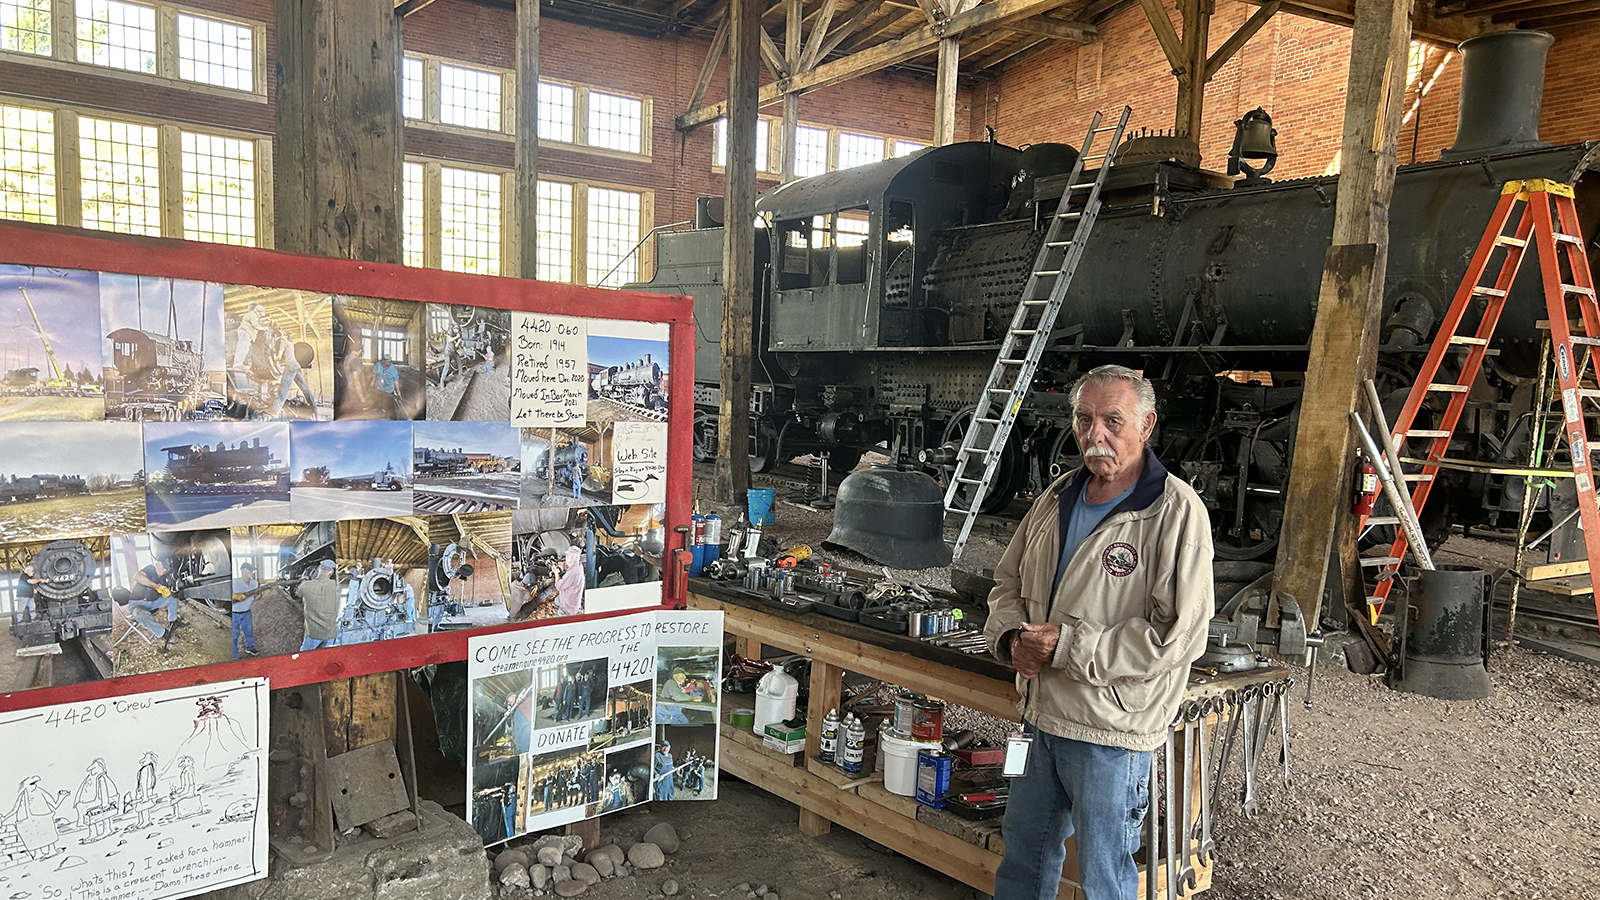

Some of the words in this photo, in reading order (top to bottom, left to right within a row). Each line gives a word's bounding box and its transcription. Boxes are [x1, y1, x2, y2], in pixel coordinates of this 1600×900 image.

[520, 317, 551, 333] 4420
[549, 339, 566, 352] 1914
[516, 353, 550, 369] Retired
[555, 358, 576, 370] 1957
[515, 368, 540, 383] Moved
[541, 371, 556, 383] here
[571, 373, 585, 383] 2020
[513, 387, 539, 399] Moved
[562, 388, 583, 398] March
[564, 398, 578, 407] 2021
[515, 407, 532, 420] Let
[617, 448, 638, 461] Web
[641, 446, 658, 460] Site
[475, 643, 521, 664] COME
[524, 638, 550, 657] SEE
[551, 635, 576, 652] THE
[577, 624, 638, 648] PROGRESS
[639, 622, 652, 638] TO
[654, 621, 710, 635] RESTORE
[619, 641, 641, 655] THE
[611, 655, 655, 680] 4420!
[45, 703, 107, 728] 4420
[537, 725, 587, 748] DONATE
[144, 856, 153, 871] I
[156, 849, 185, 867] asked
[78, 889, 100, 900] This
[103, 885, 111, 895] is
